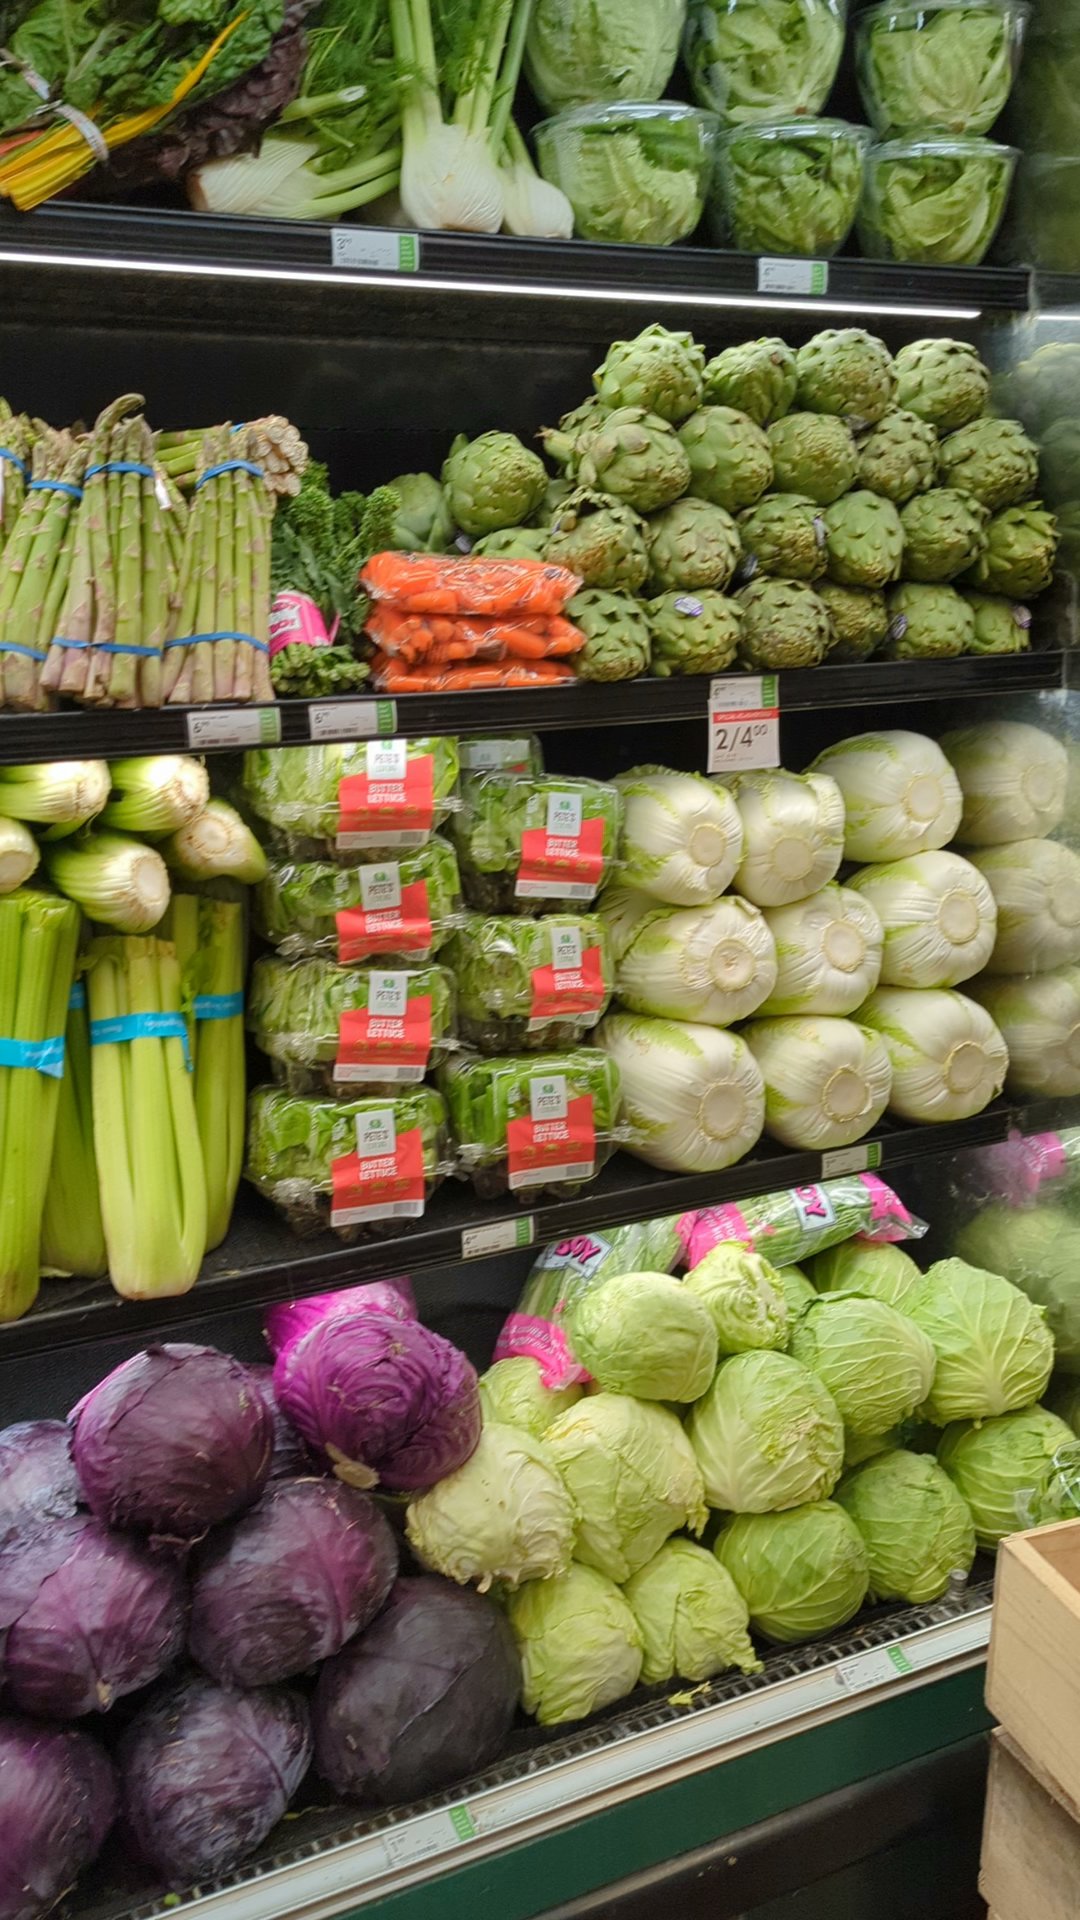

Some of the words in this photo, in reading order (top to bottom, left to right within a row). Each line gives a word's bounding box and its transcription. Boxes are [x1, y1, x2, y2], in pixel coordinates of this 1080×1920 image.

[365, 911, 400, 924] BUTTER
[365, 920, 404, 933] LETTUCE
[369, 1018, 404, 1029] BUTTER
[366, 1029, 406, 1039] LETTUCE
[534, 1121, 567, 1133] BUTTER
[533, 1130, 570, 1143] LETTUCE
[359, 1157, 395, 1170] BUTTER
[359, 1167, 398, 1180] LETTUCE
